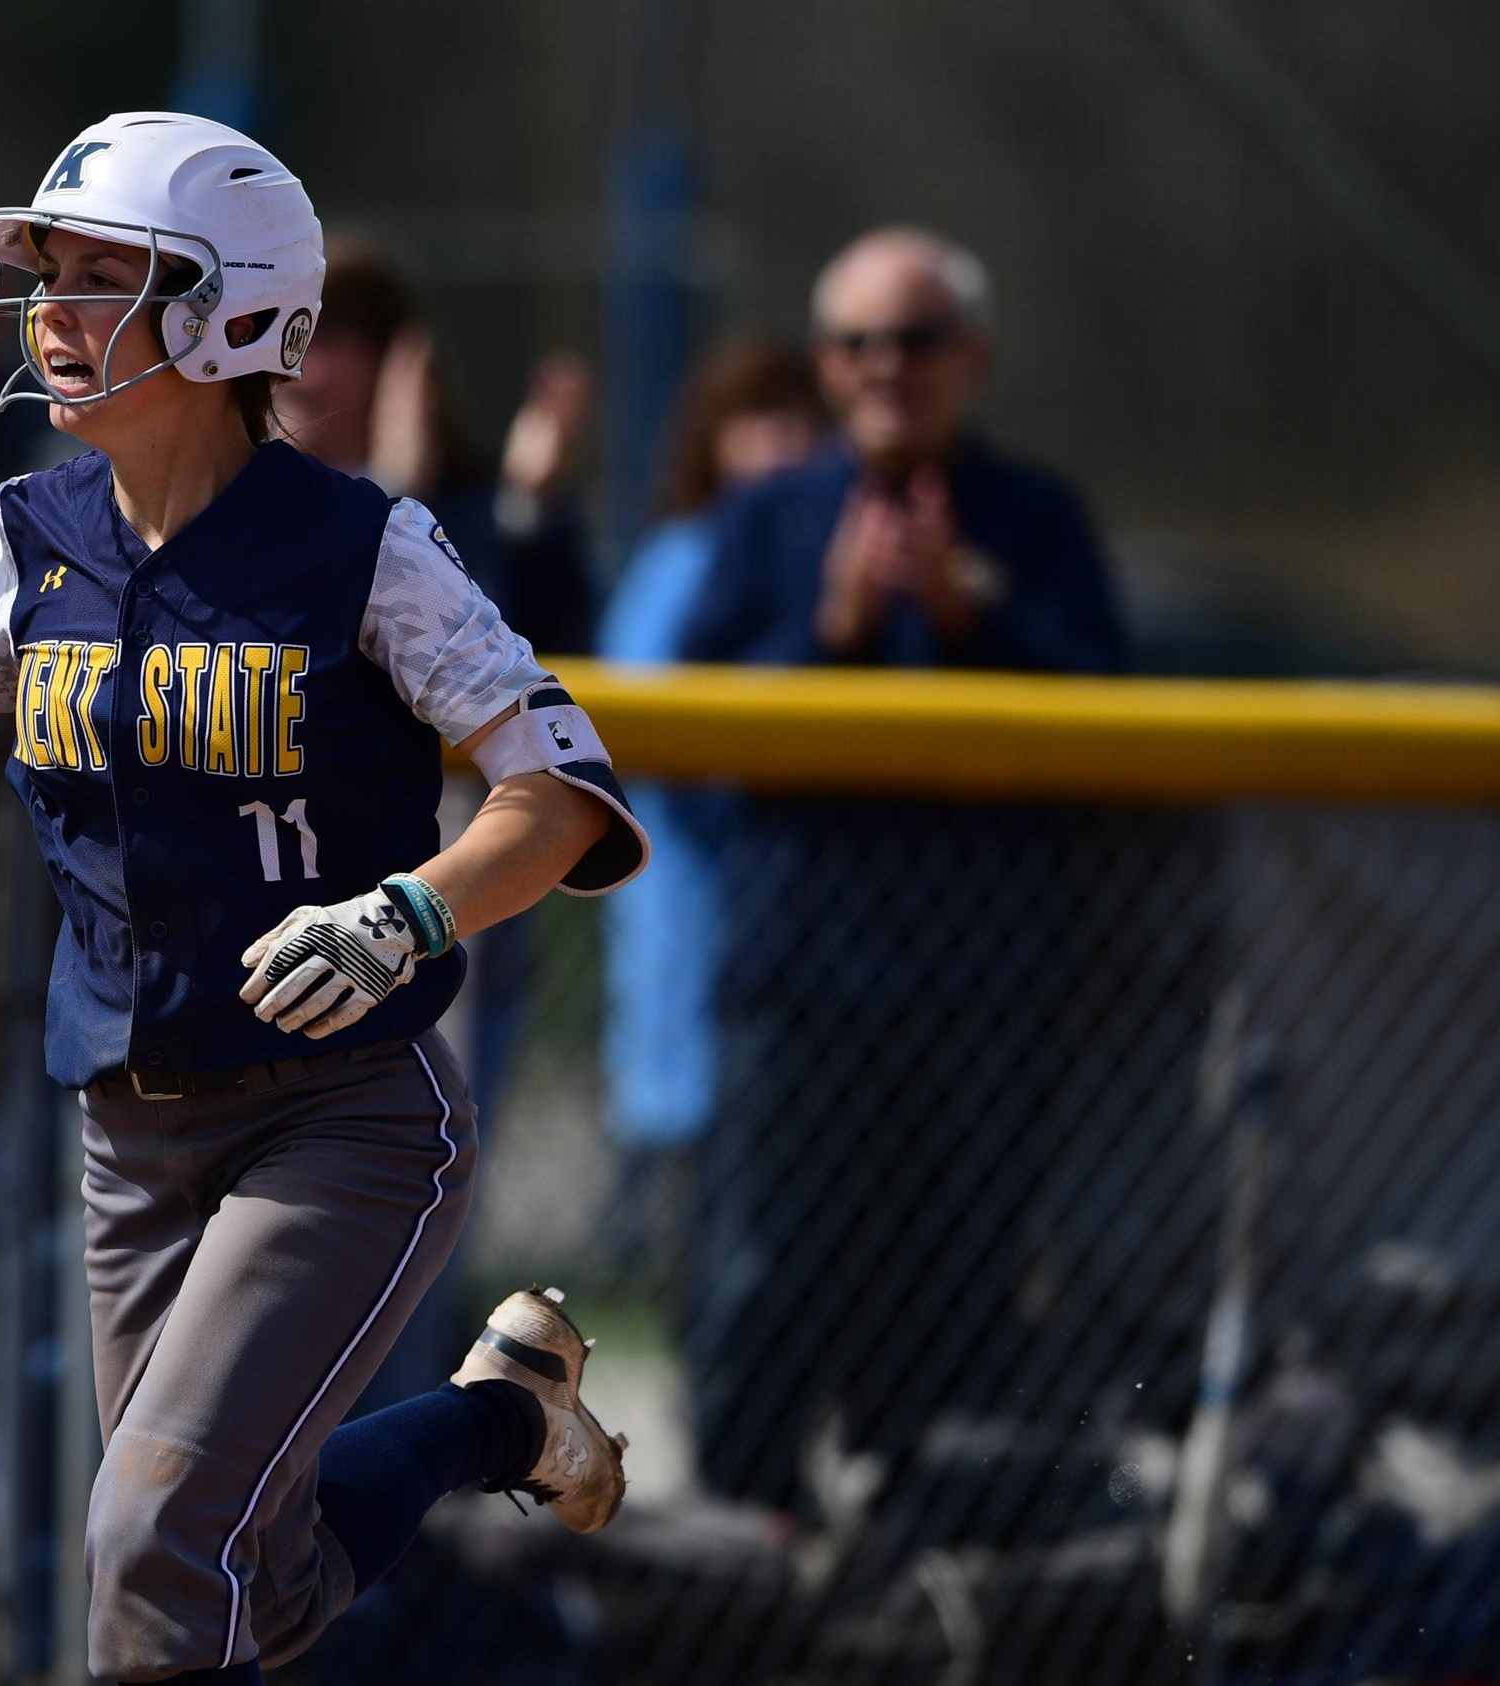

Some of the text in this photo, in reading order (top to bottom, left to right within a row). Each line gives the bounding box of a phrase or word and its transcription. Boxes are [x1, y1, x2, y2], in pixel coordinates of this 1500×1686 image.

[42, 141, 113, 194] K
[247, 262, 275, 270] ARMOUR
[136, 642, 310, 778] STATE
[238, 798, 320, 881] 11
